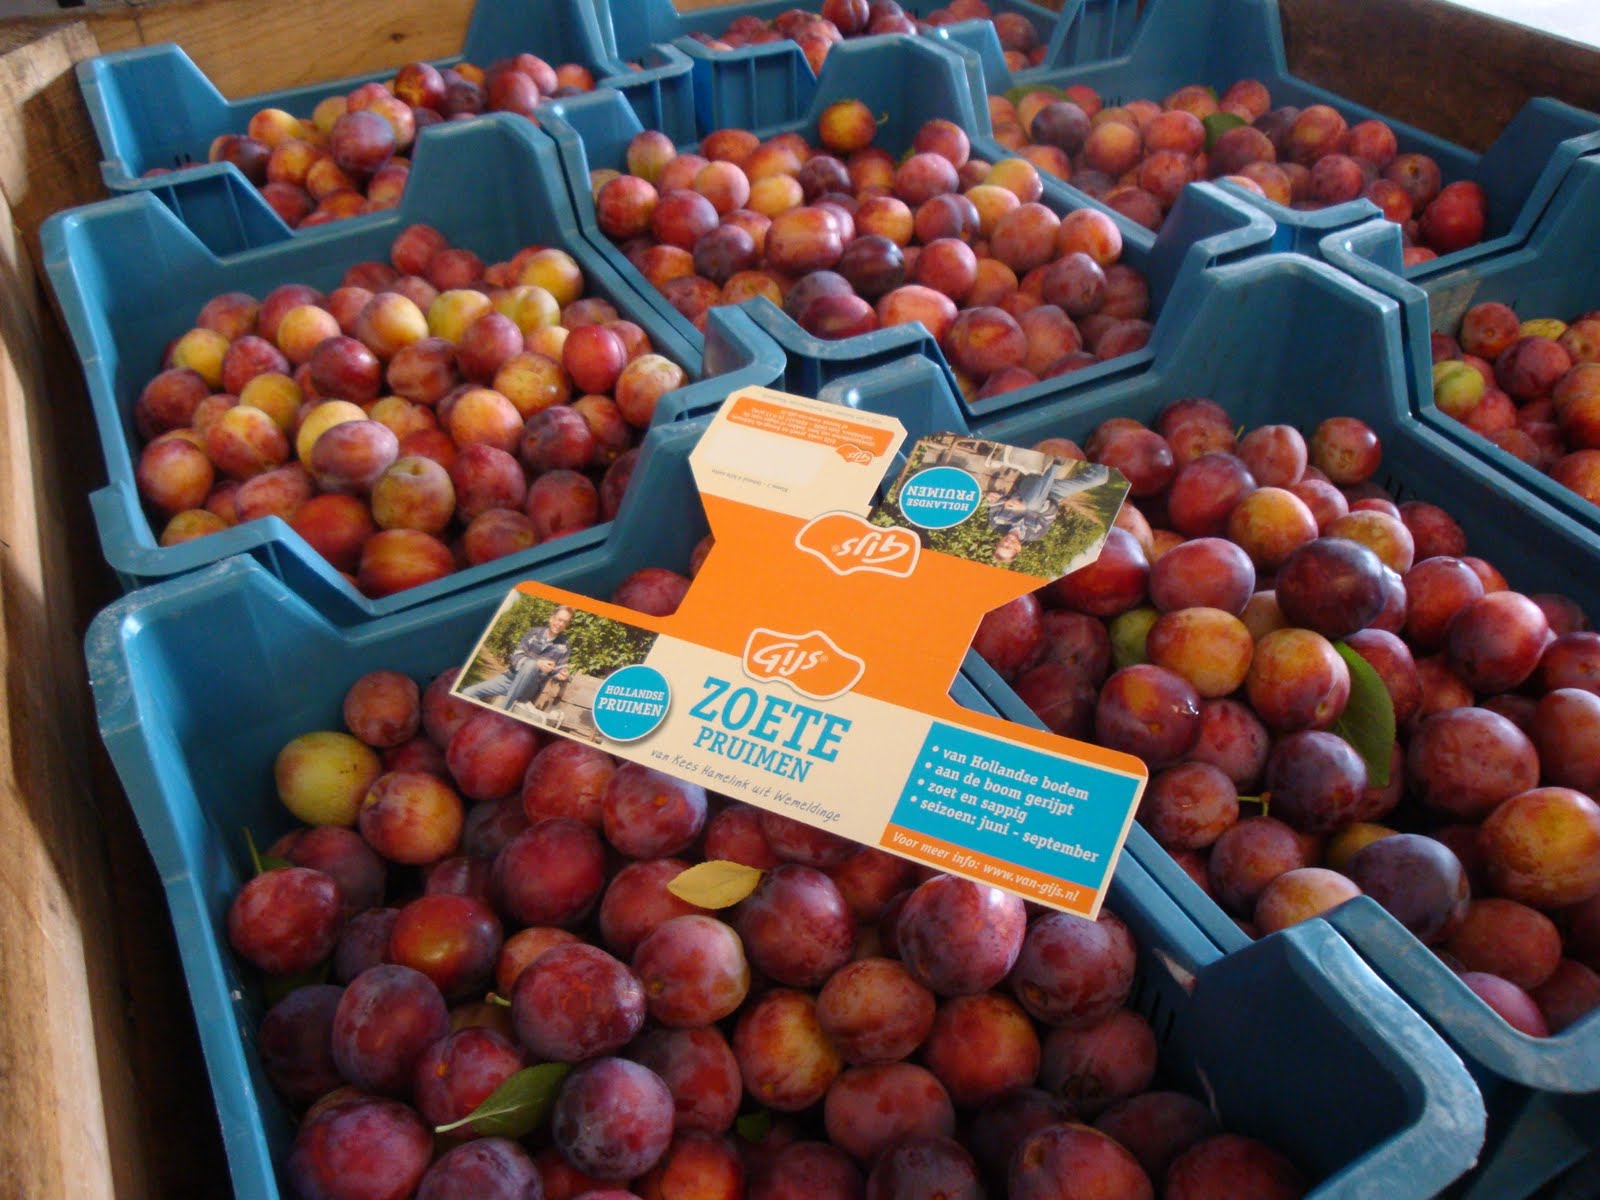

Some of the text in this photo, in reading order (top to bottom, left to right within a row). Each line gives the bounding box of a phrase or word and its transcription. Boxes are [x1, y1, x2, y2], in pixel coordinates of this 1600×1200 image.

[906, 485, 976, 501] PRUIMEN
[906, 497, 969, 512] HOLLANDSE
[597, 698, 663, 718] PRUIMEN
[605, 685, 665, 702] HOLLANDSE
[689, 676, 852, 763] ZOETE
[693, 726, 814, 783] PRUIMEN
[943, 749, 1089, 801] van Hollandse bodem
[651, 749, 841, 823] van Kees Hamelink uit Wemeldinge
[928, 781, 1028, 824] zoet en sappig
[935, 765, 1075, 817] aan de boom gerijpt
[920, 799, 977, 825] seizoen:
[977, 815, 1011, 836] juni
[1022, 831, 1100, 863] september
[892, 831, 1081, 902] Voor meer info: www.van-gijs.nl
